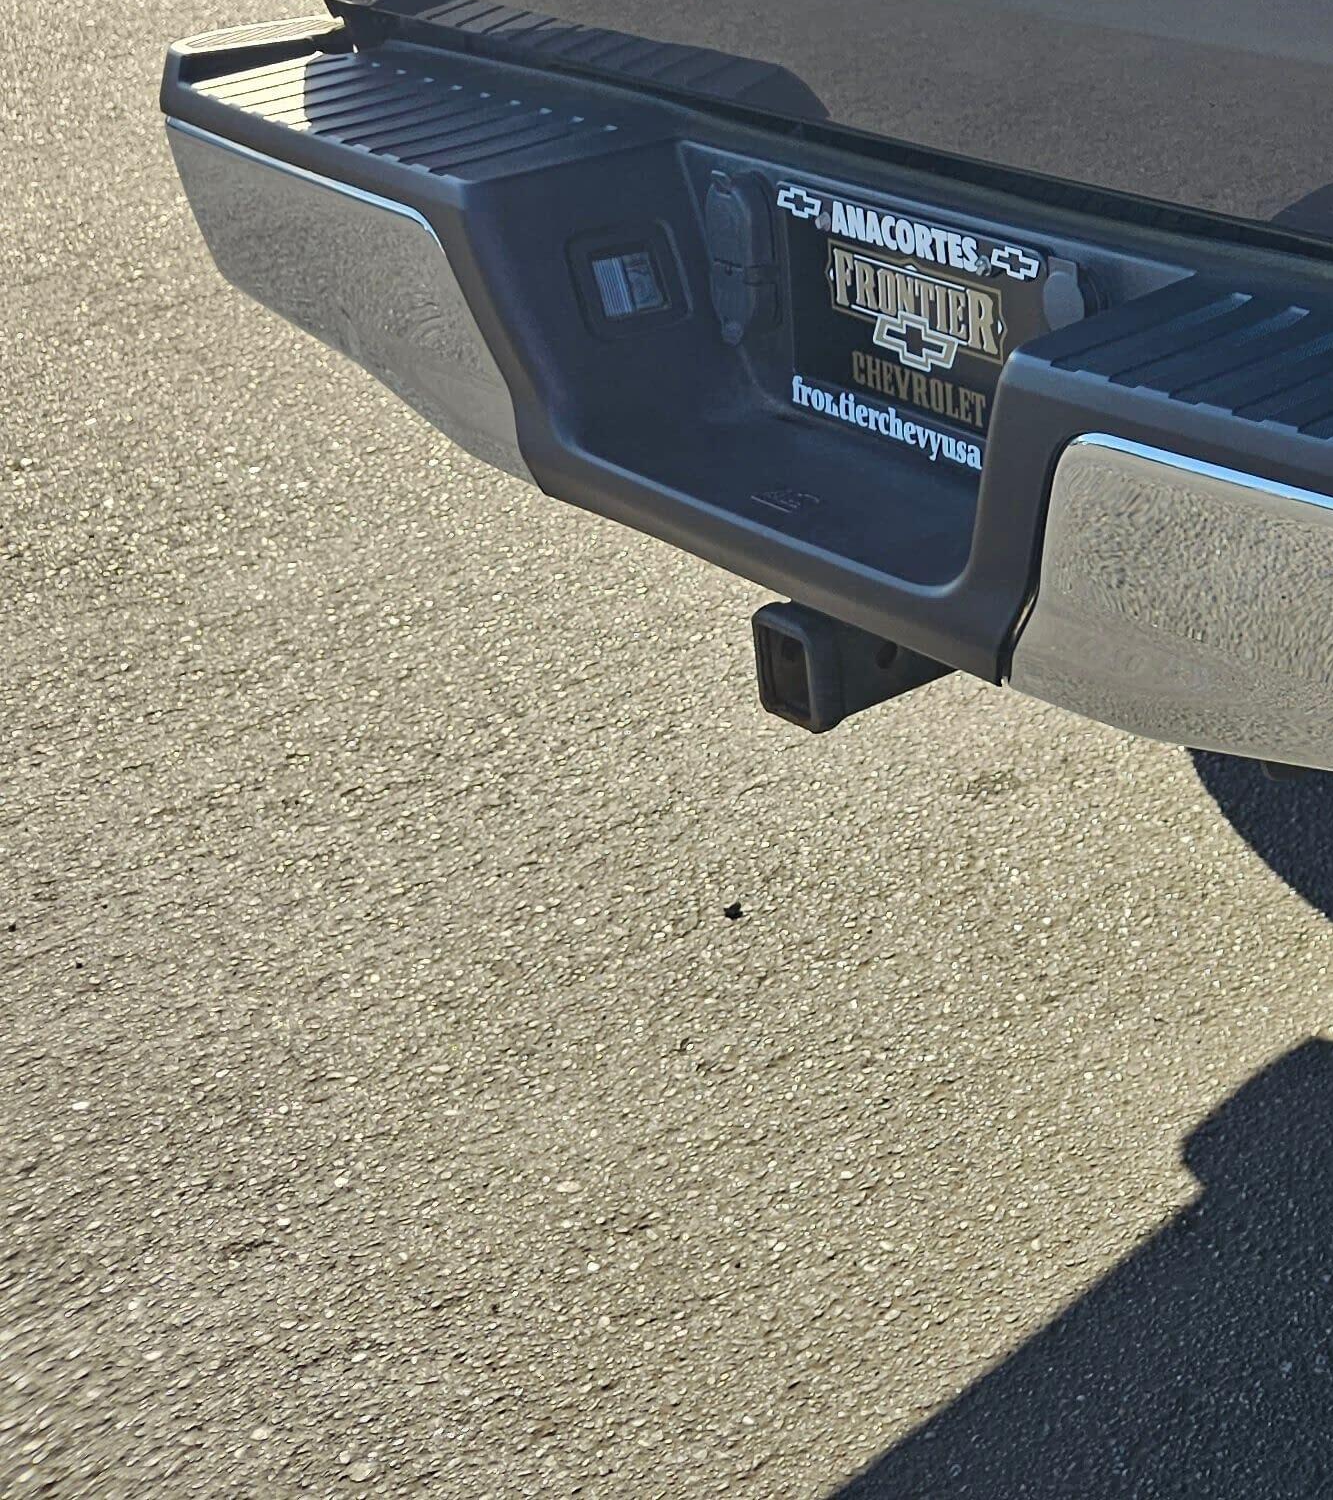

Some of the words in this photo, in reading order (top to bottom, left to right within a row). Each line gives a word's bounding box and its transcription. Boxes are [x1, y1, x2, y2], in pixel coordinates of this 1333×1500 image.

[831, 200, 980, 274] ANACORTES
[832, 247, 999, 355] FRONTIER
[851, 350, 987, 429] CHEVROLET
